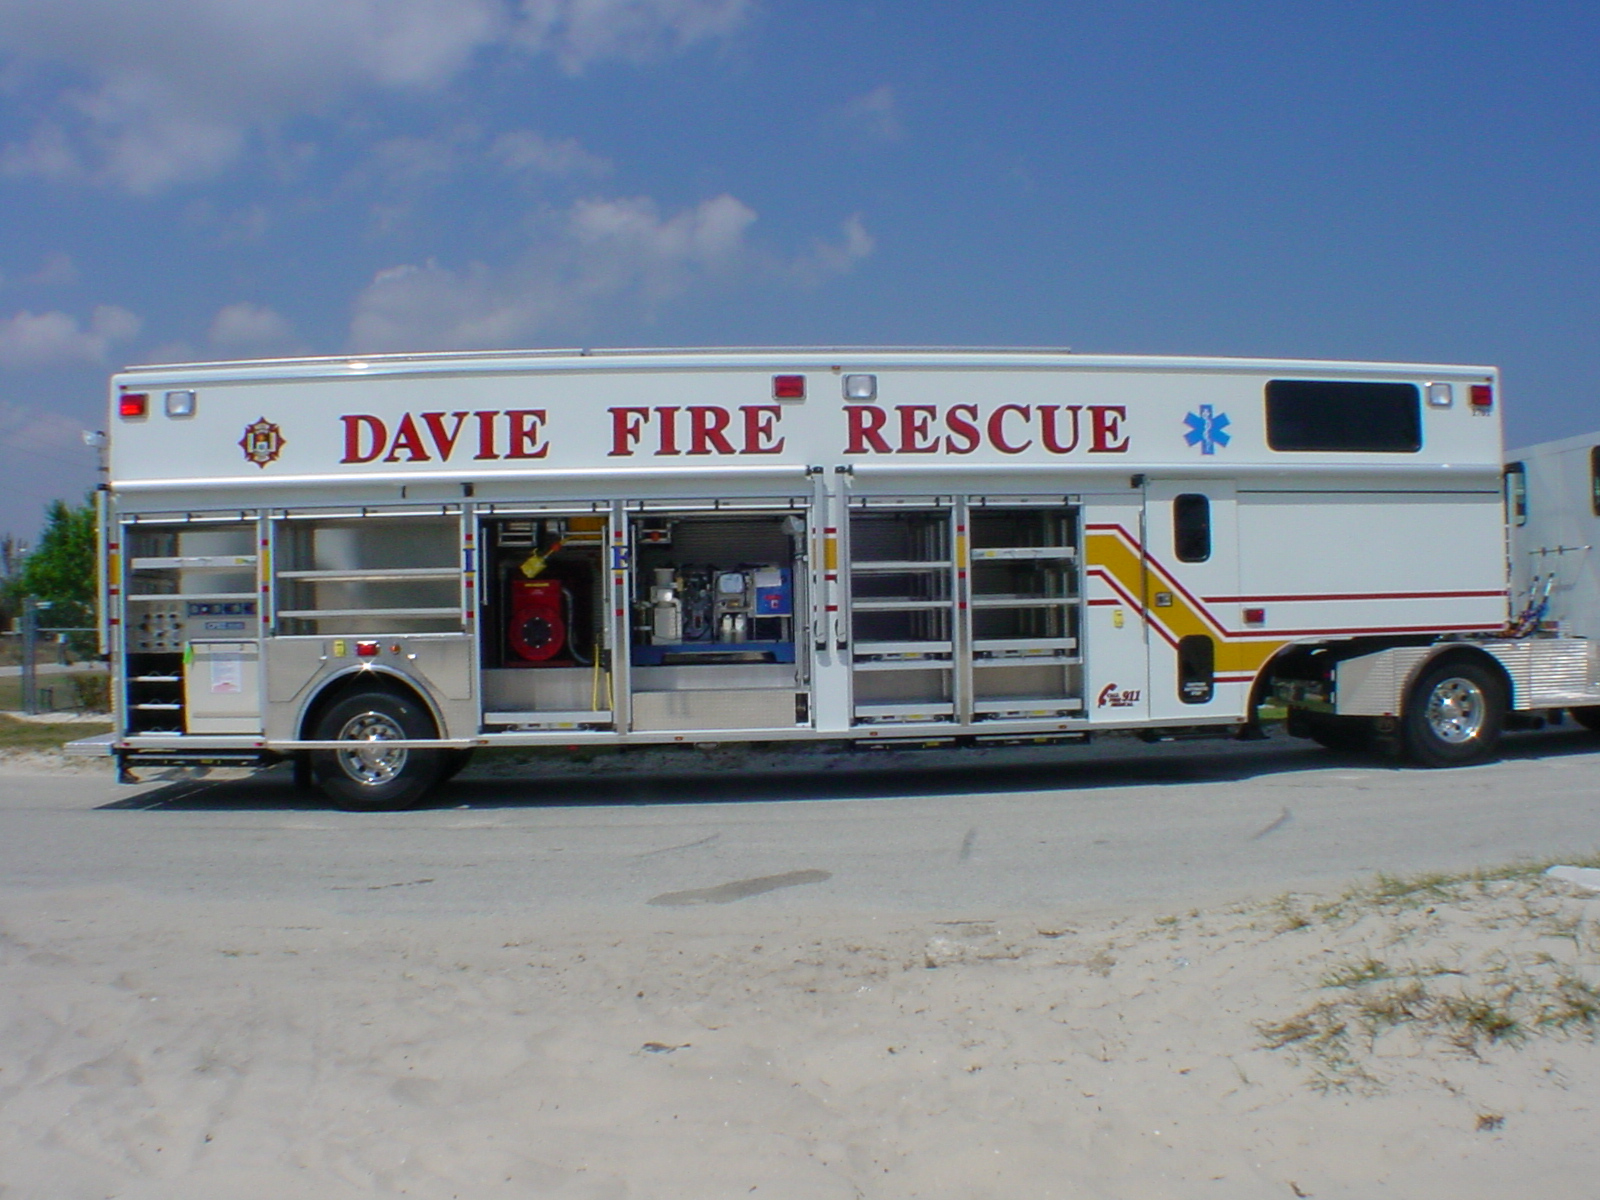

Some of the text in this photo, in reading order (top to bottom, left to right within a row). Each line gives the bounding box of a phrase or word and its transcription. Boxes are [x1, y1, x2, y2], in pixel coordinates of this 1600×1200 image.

[339, 403, 1130, 464] DAVIE FIRE RESCUE
[1121, 690, 1140, 702] 911
